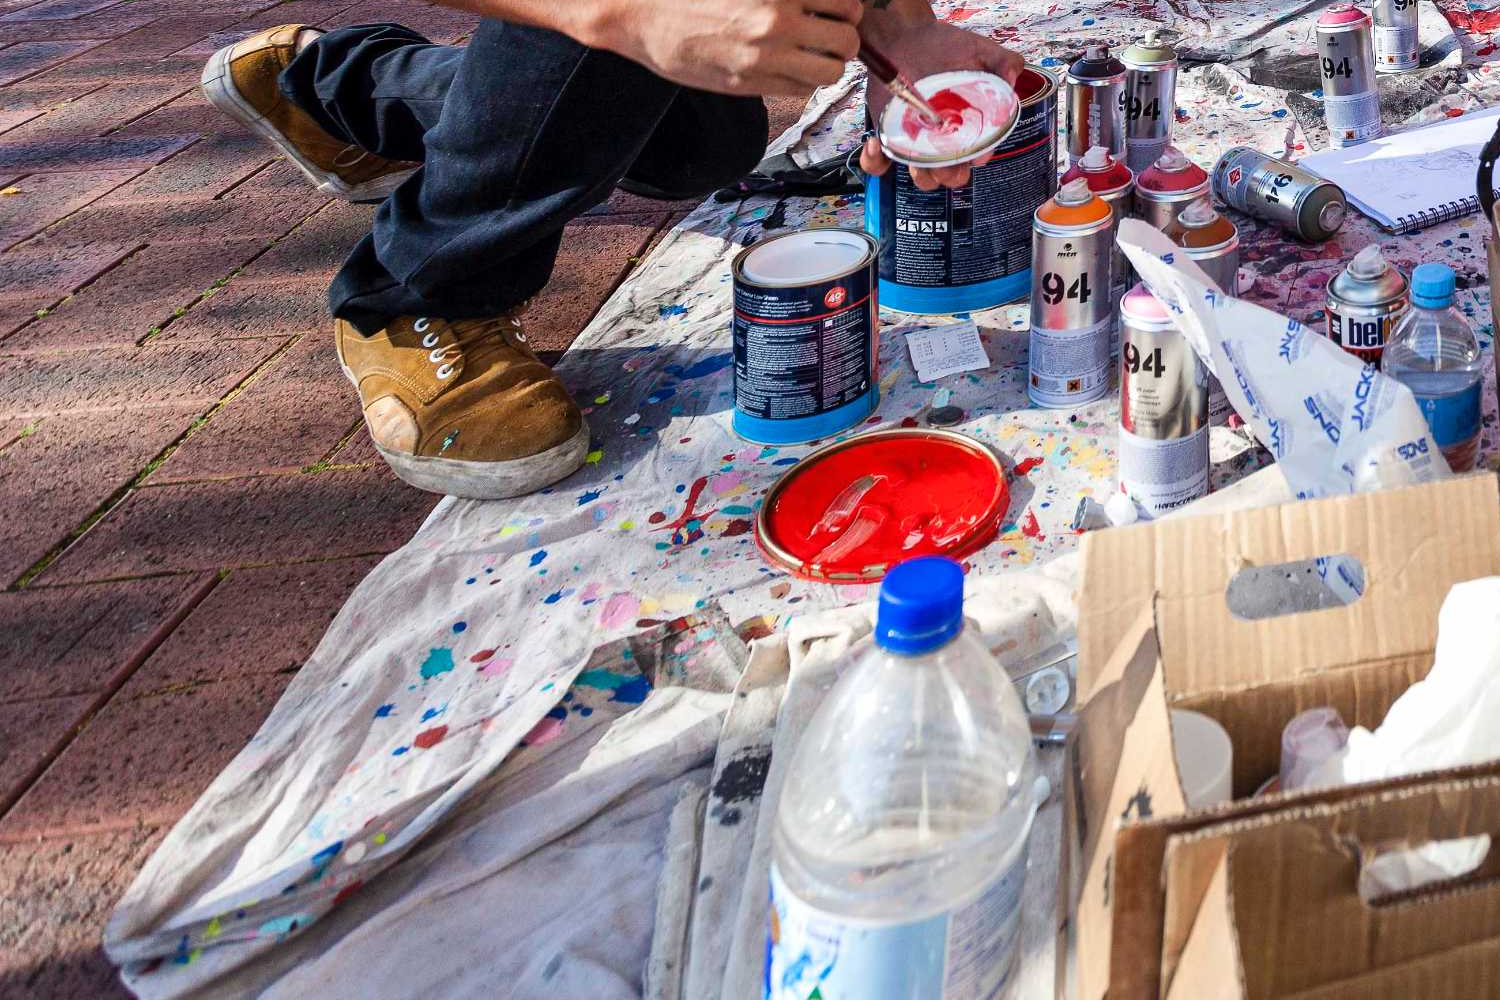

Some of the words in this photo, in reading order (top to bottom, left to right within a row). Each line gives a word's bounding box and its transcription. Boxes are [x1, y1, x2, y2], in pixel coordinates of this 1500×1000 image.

[1322, 56, 1353, 79] 94
[1042, 272, 1091, 305] 94
[1123, 342, 1166, 378] 94
